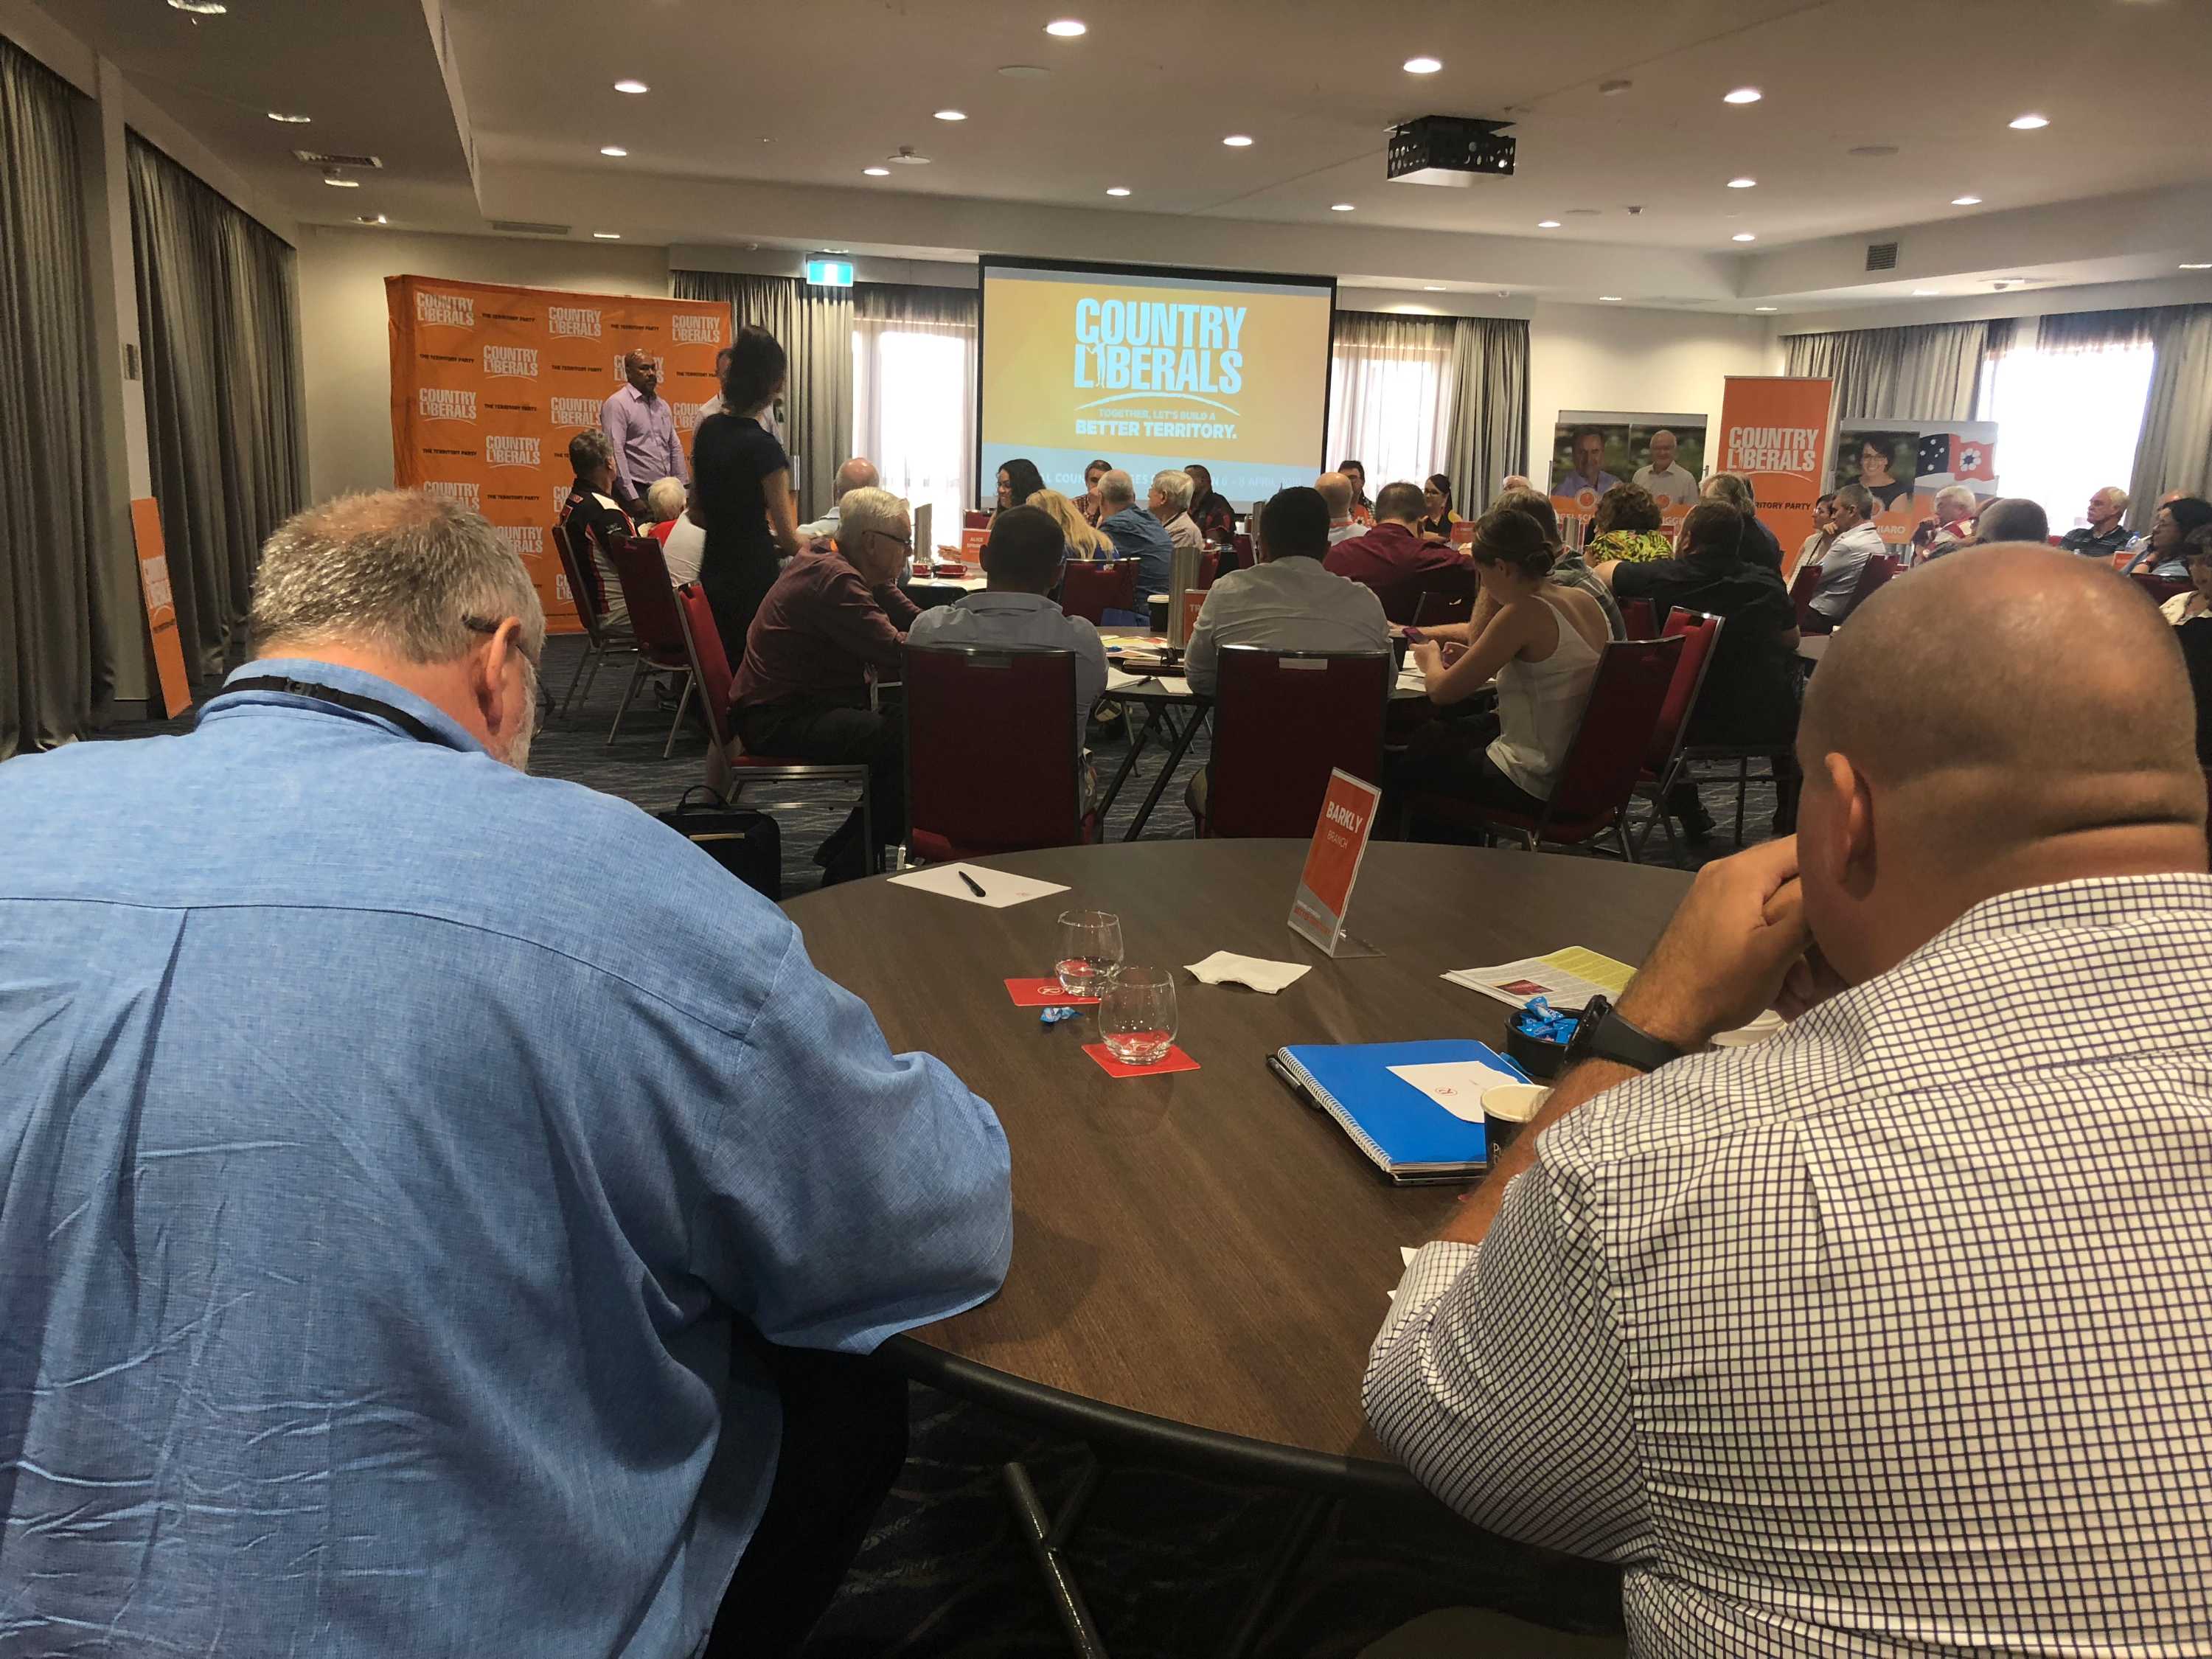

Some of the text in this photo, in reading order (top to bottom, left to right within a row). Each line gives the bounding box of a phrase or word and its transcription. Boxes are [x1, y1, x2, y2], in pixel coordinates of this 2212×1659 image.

[417, 291, 474, 312] COUNTRY
[417, 306, 475, 327] LIBERALS
[549, 307, 602, 324] COUNTRY
[672, 315, 720, 330] COUNTRY
[1075, 297, 1248, 350] COUNTRY
[549, 320, 602, 337] LIBERALS
[672, 328, 720, 343] LIBERALS
[483, 345, 538, 363] COUNTRY
[483, 358, 538, 377] LIBERALS
[1074, 342, 1243, 395] LIBERALS
[419, 388, 476, 406] COUNTRY
[551, 397, 603, 412] COUNTRY
[420, 402, 476, 420] LIBERALS
[1209, 411, 1216, 420] A
[1075, 419, 1239, 439] BETTER TERRITORY.
[486, 435, 540, 452] COUNTRY
[1728, 427, 1819, 450] COUNTRY
[486, 448, 540, 465] LIBERALS
[1727, 447, 1816, 472] LIBERALS
[1784, 502, 1811, 510] PARTY
[497, 526, 543, 540] OUNTRY
[1326, 801, 1363, 834] BARKLY
[1328, 830, 1349, 850] BRANCH
